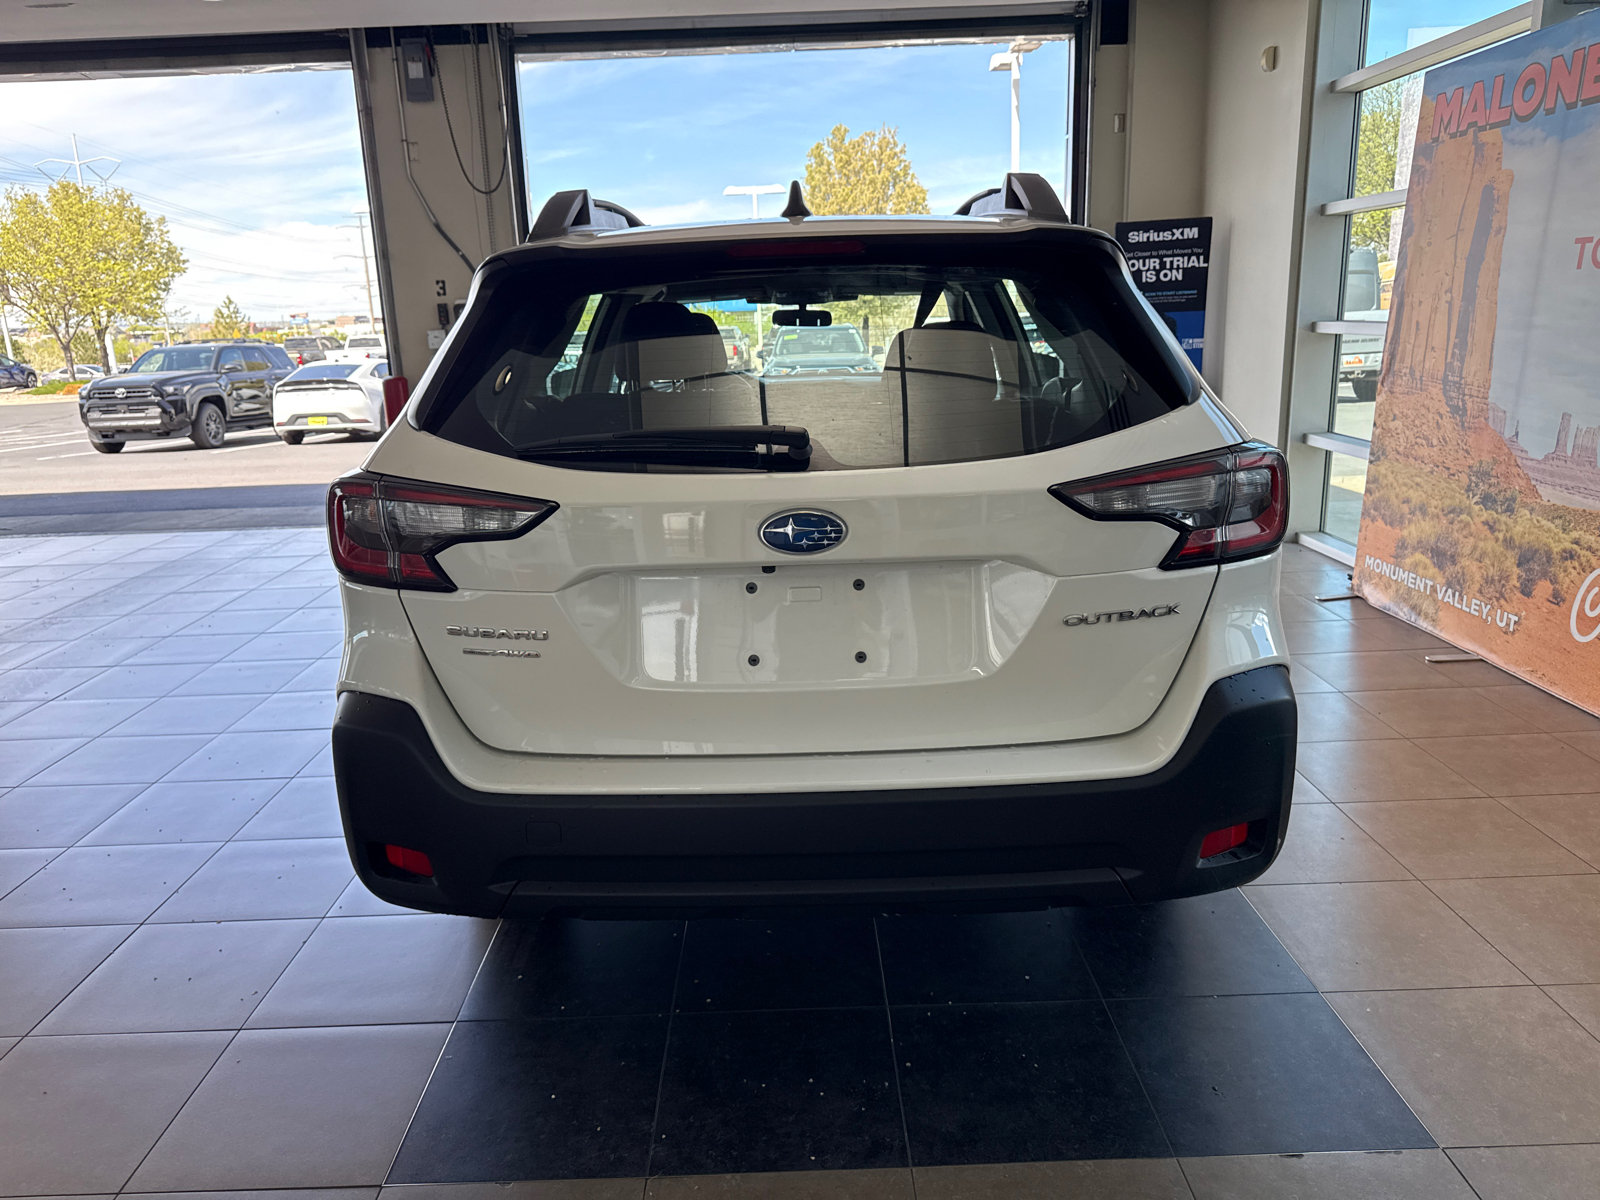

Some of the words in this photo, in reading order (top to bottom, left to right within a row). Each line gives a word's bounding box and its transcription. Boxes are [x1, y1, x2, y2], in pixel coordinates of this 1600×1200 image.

[1128, 227, 1199, 243] SiriusXM
[1129, 258, 1160, 271] OUR
[1163, 255, 1208, 269] TRIAL
[1142, 270, 1157, 283] IS
[1160, 269, 1183, 282] ON
[435, 279, 447, 297] 3
[1364, 555, 1434, 595] MONUMENT
[1436, 583, 1492, 625] VALLEY,
[1495, 611, 1519, 632] UT
[1062, 602, 1181, 627] OUTBACK
[446, 624, 549, 641] SUBARU
[490, 648, 541, 658] AWD
